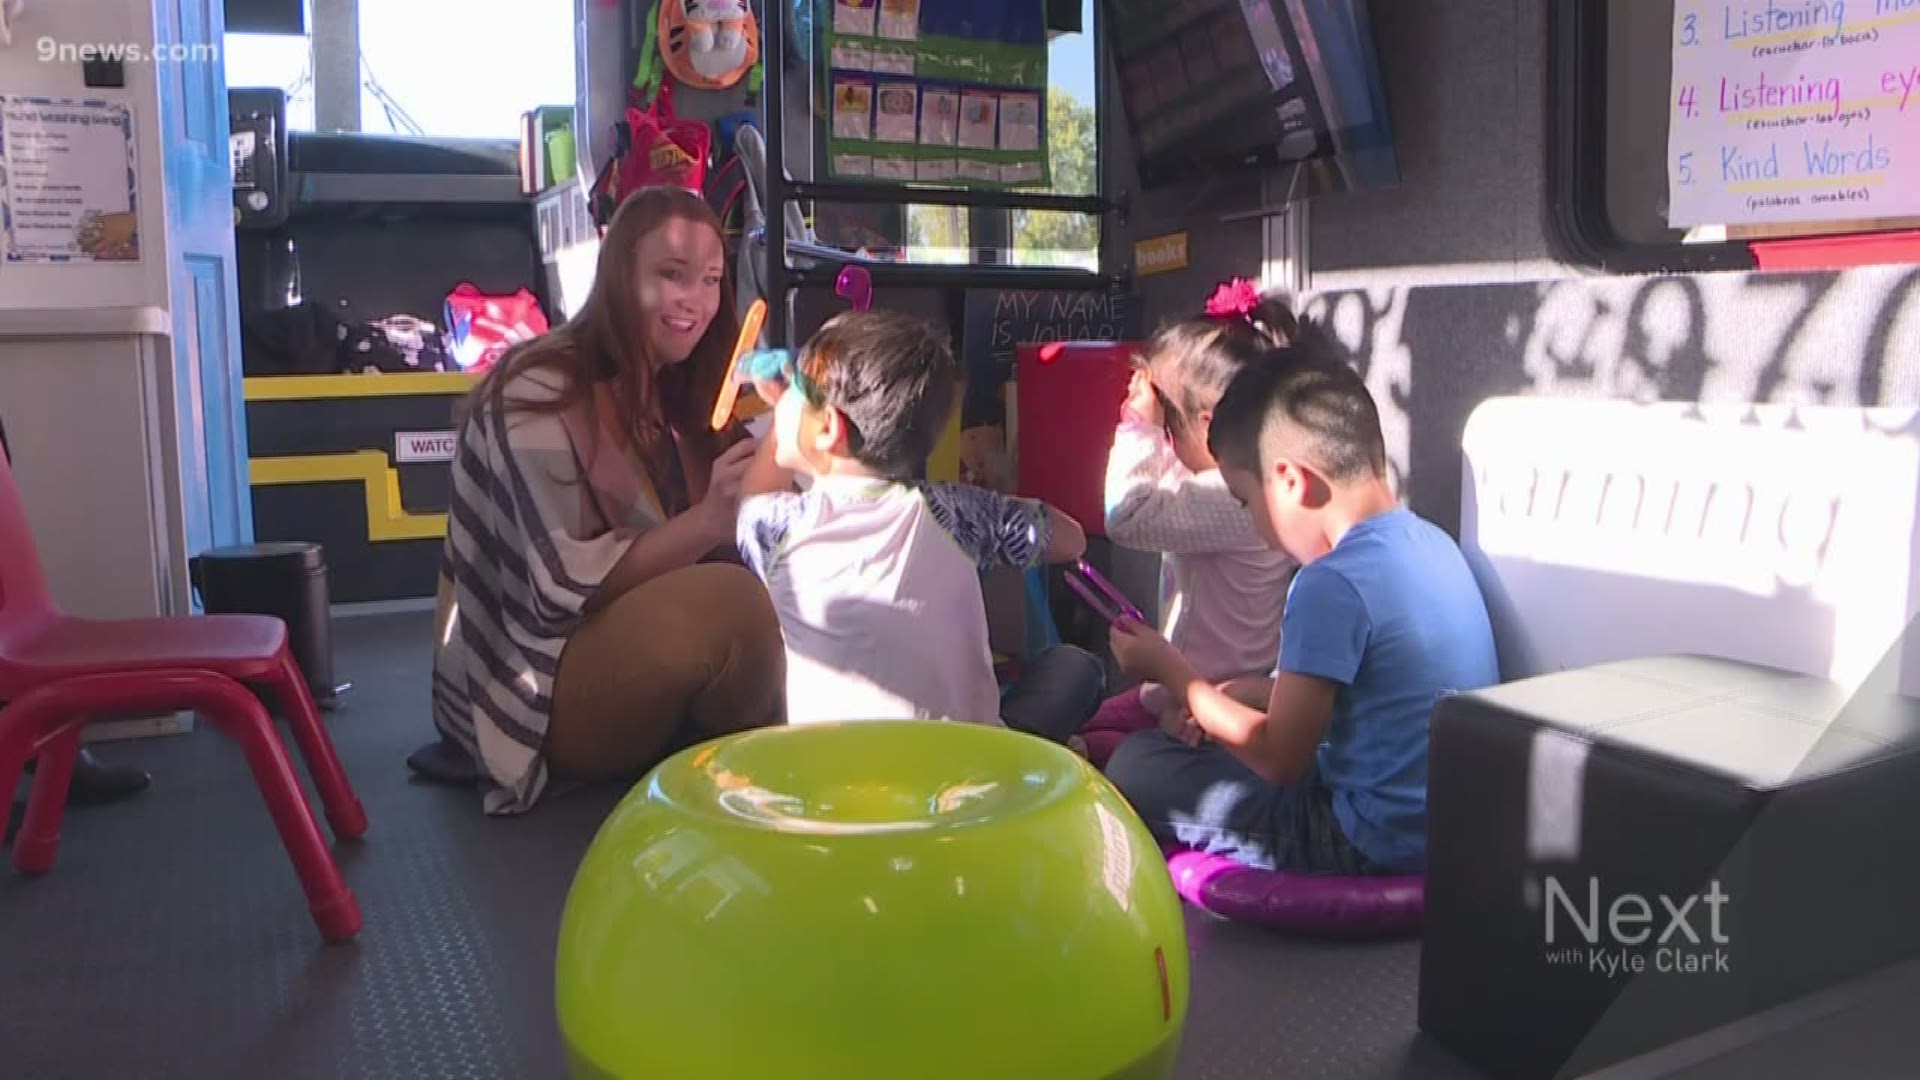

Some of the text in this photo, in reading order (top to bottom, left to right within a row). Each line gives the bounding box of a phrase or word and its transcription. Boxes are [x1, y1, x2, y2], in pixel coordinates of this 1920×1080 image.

[1680, 12, 1700, 47] 3.
[1724, 0, 1845, 40] Listening
[1678, 84, 1700, 119] 4.
[1719, 72, 1840, 117] Listening
[1679, 132, 1892, 186] 5. Kind Words
[1746, 193, 1801, 214] (palabras
[994, 292, 1126, 321] MY NAME
[991, 321, 1012, 348] IS
